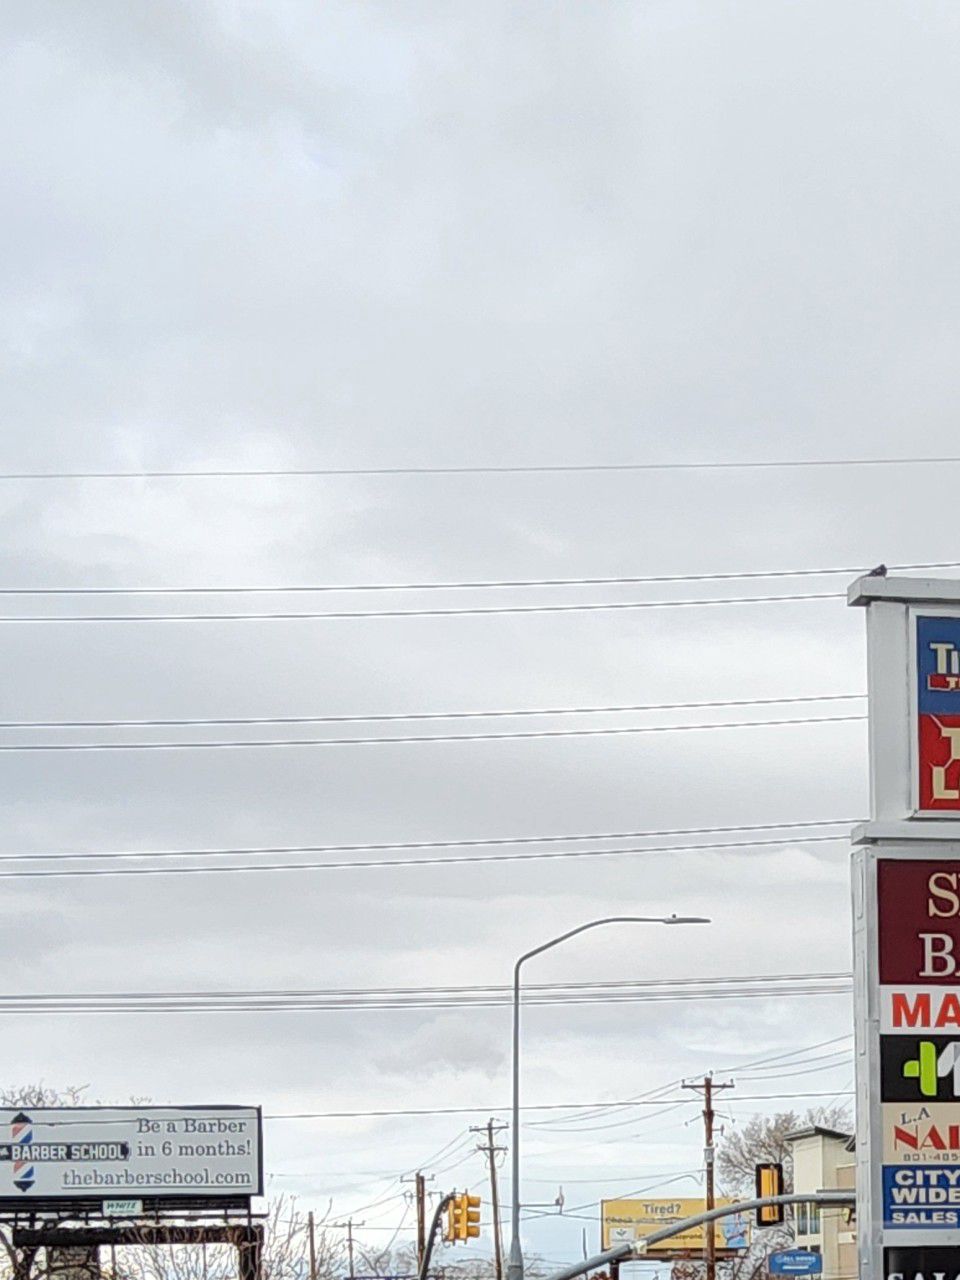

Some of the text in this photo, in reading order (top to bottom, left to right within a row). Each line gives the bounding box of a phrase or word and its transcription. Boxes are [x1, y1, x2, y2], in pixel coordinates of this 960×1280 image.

[136, 1118, 247, 1133] Be a Barber
[11, 1145, 67, 1160] BARBER
[71, 1144, 126, 1159] SCHOOL
[137, 1140, 251, 1156] in 6 months!
[63, 1169, 251, 1186] thebarberschool.com
[642, 1203, 682, 1214] Tired?
[892, 1212, 958, 1224] SALES
